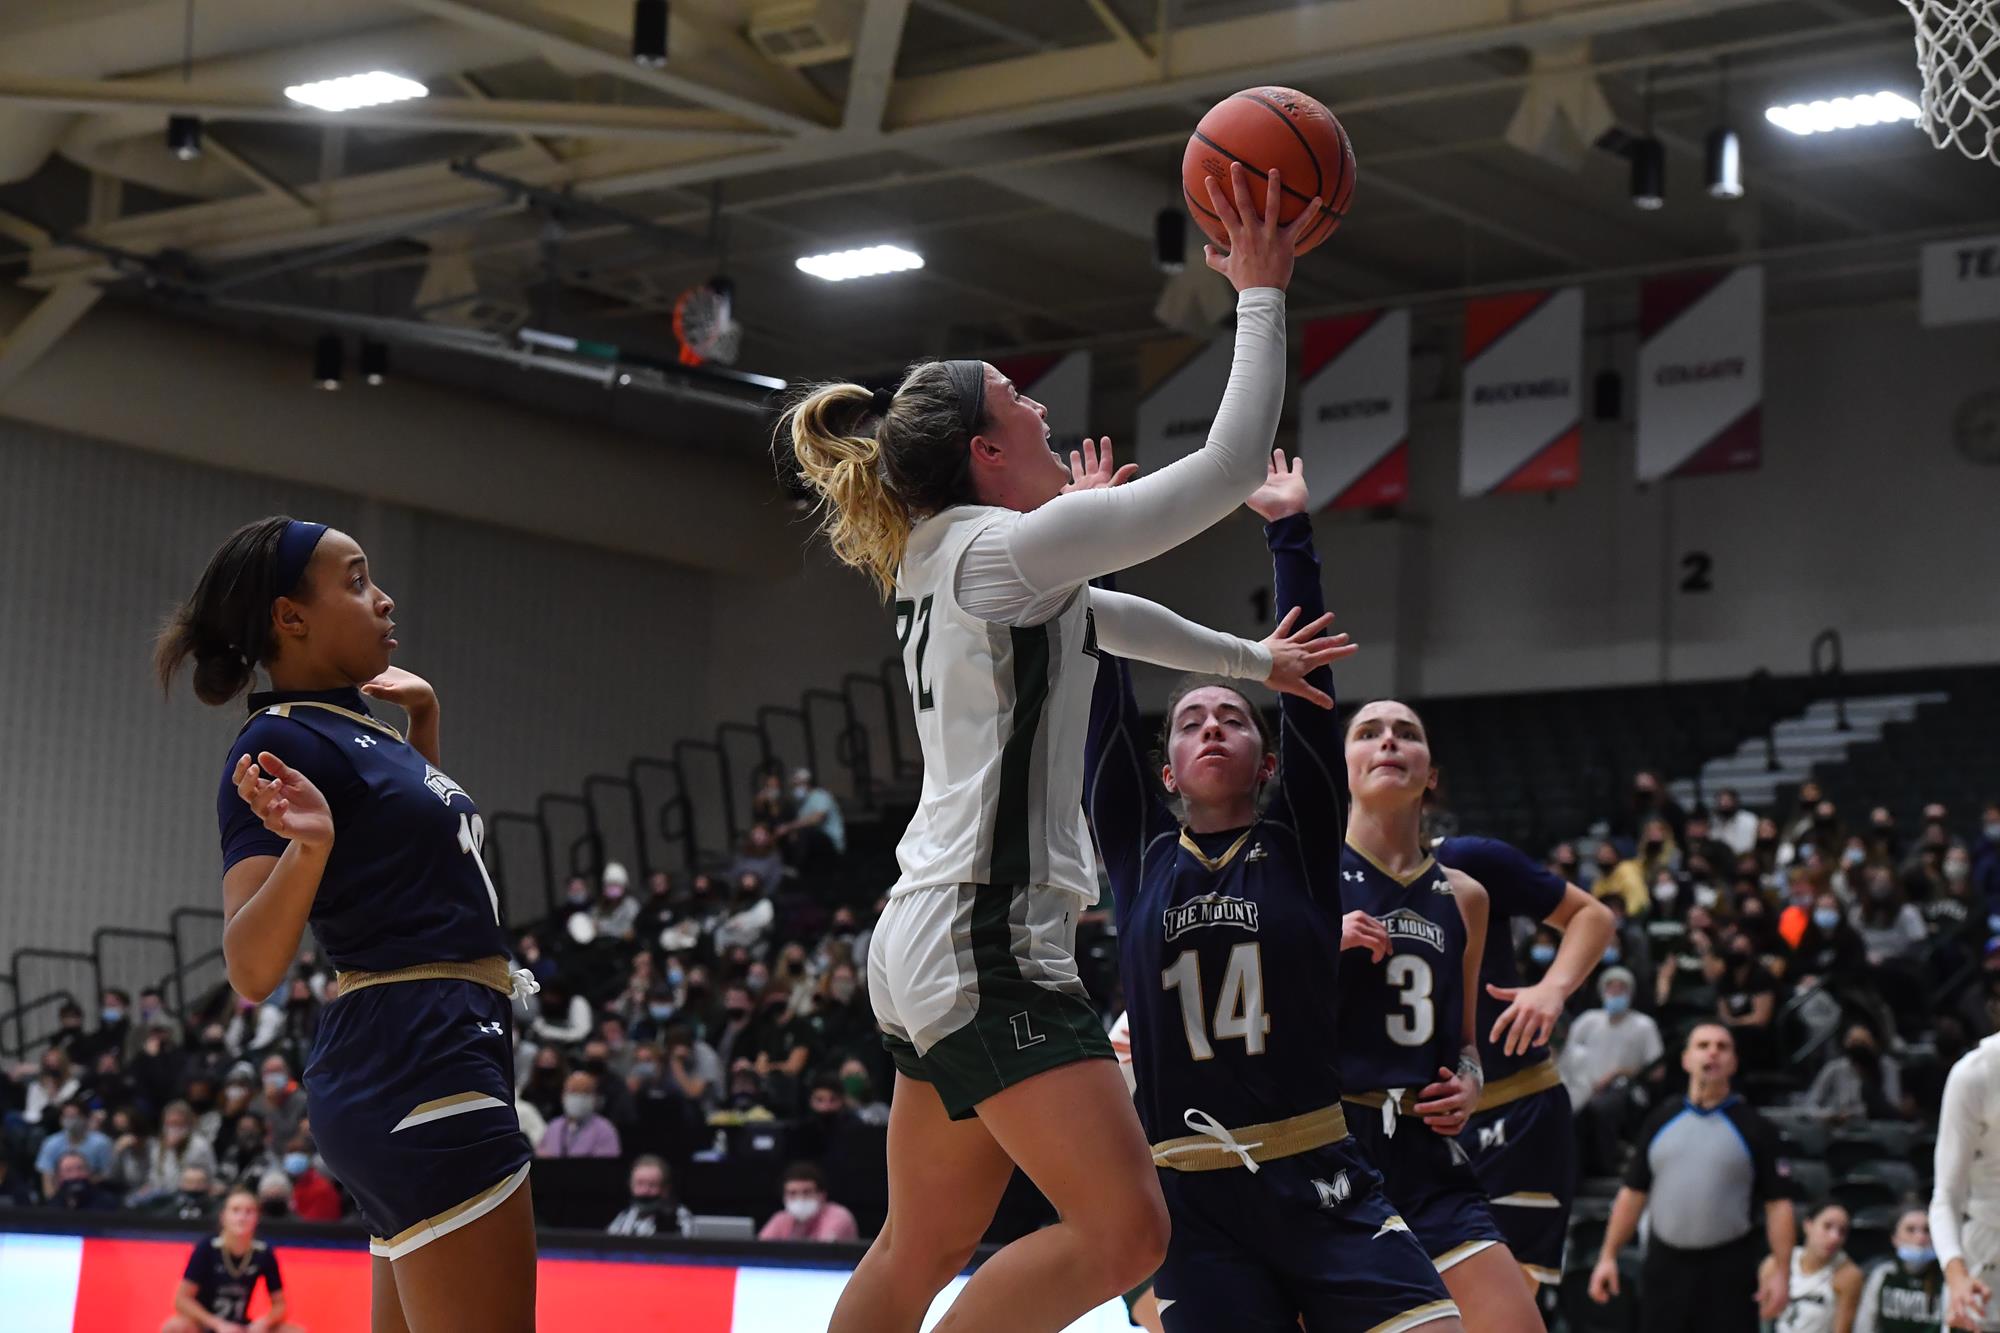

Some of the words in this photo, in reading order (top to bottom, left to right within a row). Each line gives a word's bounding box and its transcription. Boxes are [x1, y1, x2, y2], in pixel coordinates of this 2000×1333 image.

[1956, 247, 2000, 280] TE
[1318, 400, 1391, 421] BOSTON
[1682, 551, 1710, 594] 2
[1250, 586, 1267, 624] 1
[1168, 905, 1197, 935] THE
[1201, 903, 1253, 925] MOUNT
[1397, 918, 1443, 946] MOUNT
[1162, 941, 1271, 1061] 14
[1385, 953, 1435, 1047] 3
